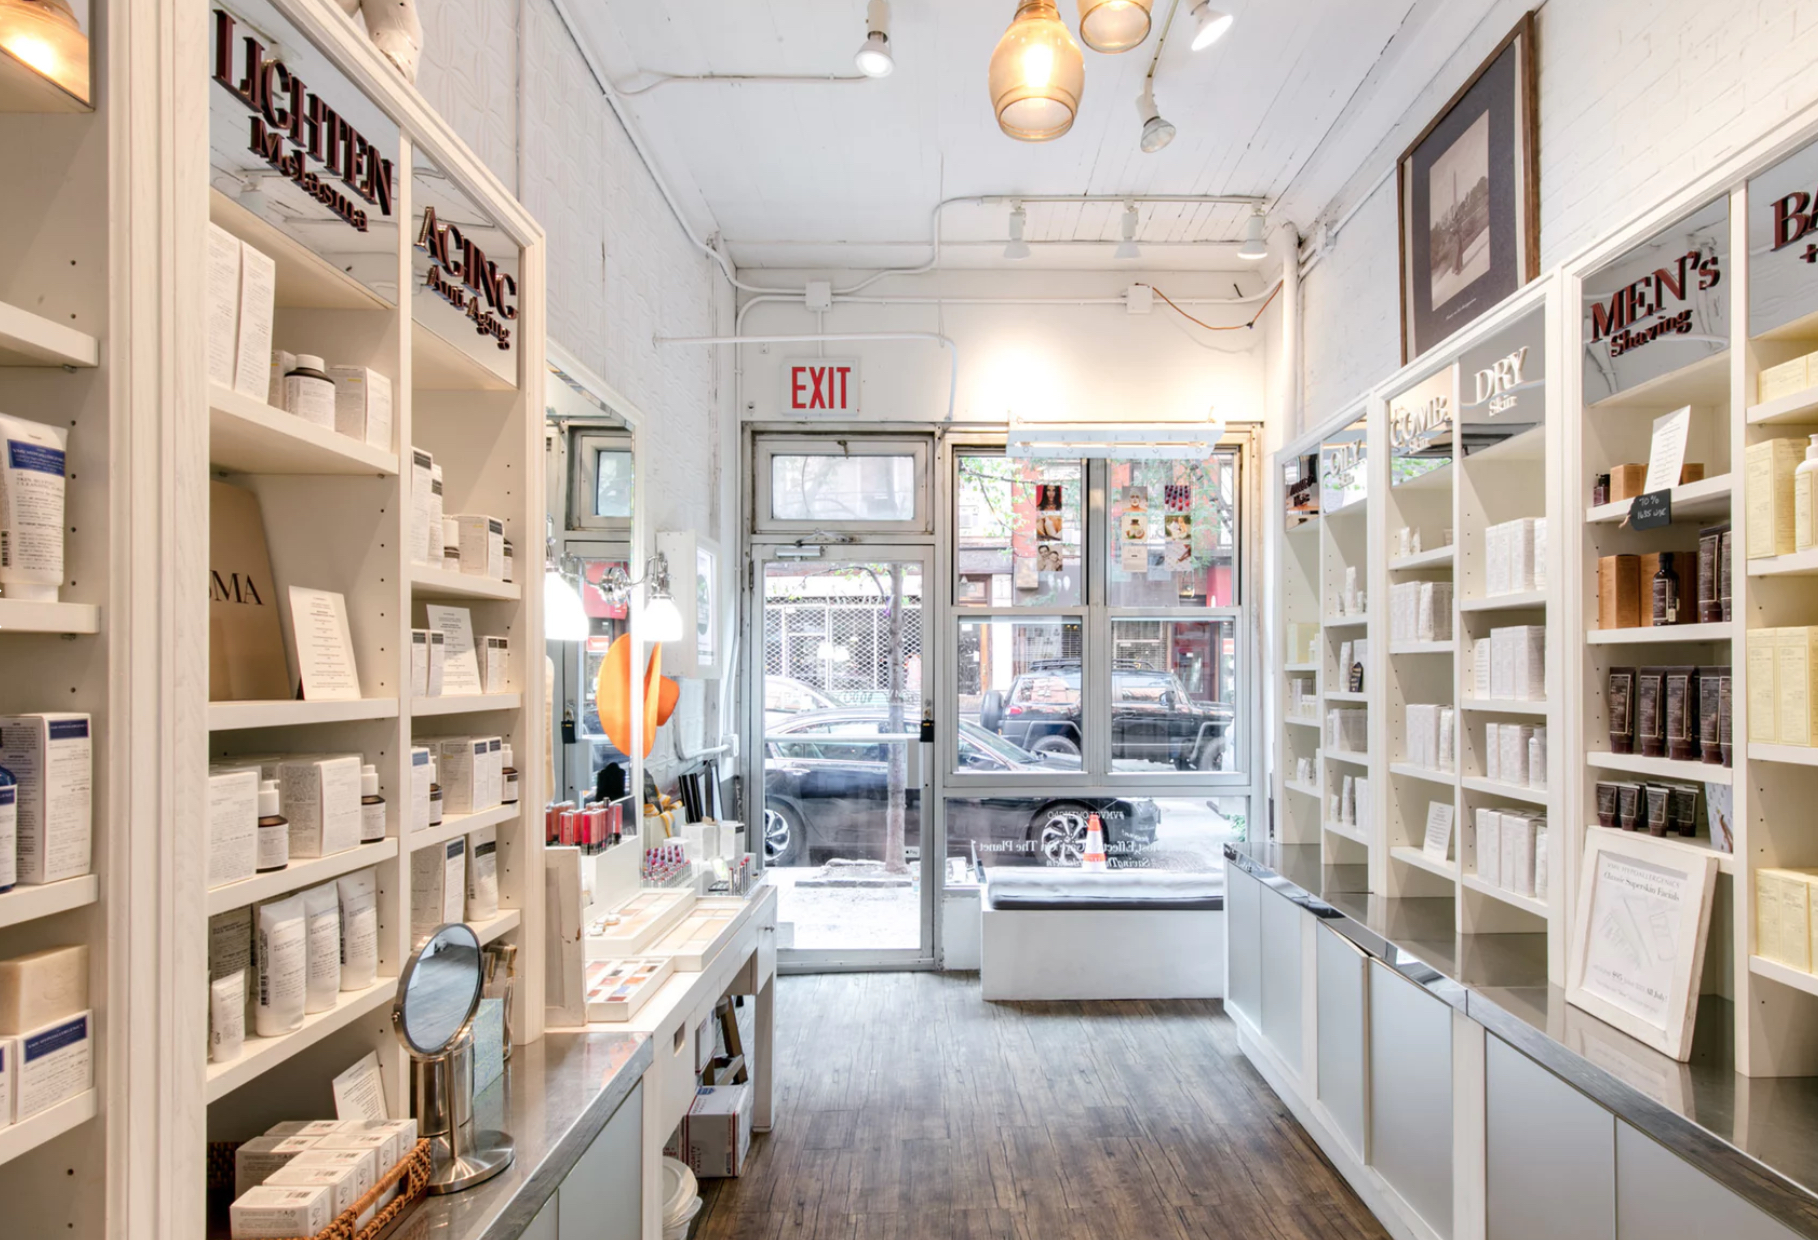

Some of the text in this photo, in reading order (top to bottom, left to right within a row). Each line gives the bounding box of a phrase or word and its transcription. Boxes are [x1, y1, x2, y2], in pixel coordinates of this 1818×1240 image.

[212, 9, 394, 216] LIGHTEN
[248, 116, 369, 232] Melasma
[414, 206, 519, 320] AGING
[420, 264, 511, 350] Anti-Aging
[1610, 309, 1693, 358] Shaving
[792, 366, 851, 409] EXIT
[1474, 345, 1530, 405] DRY
[1489, 395, 1517, 417] Skin
[209, 570, 265, 606] MA
[1603, 871, 1680, 901] Classic Superskin Facials
